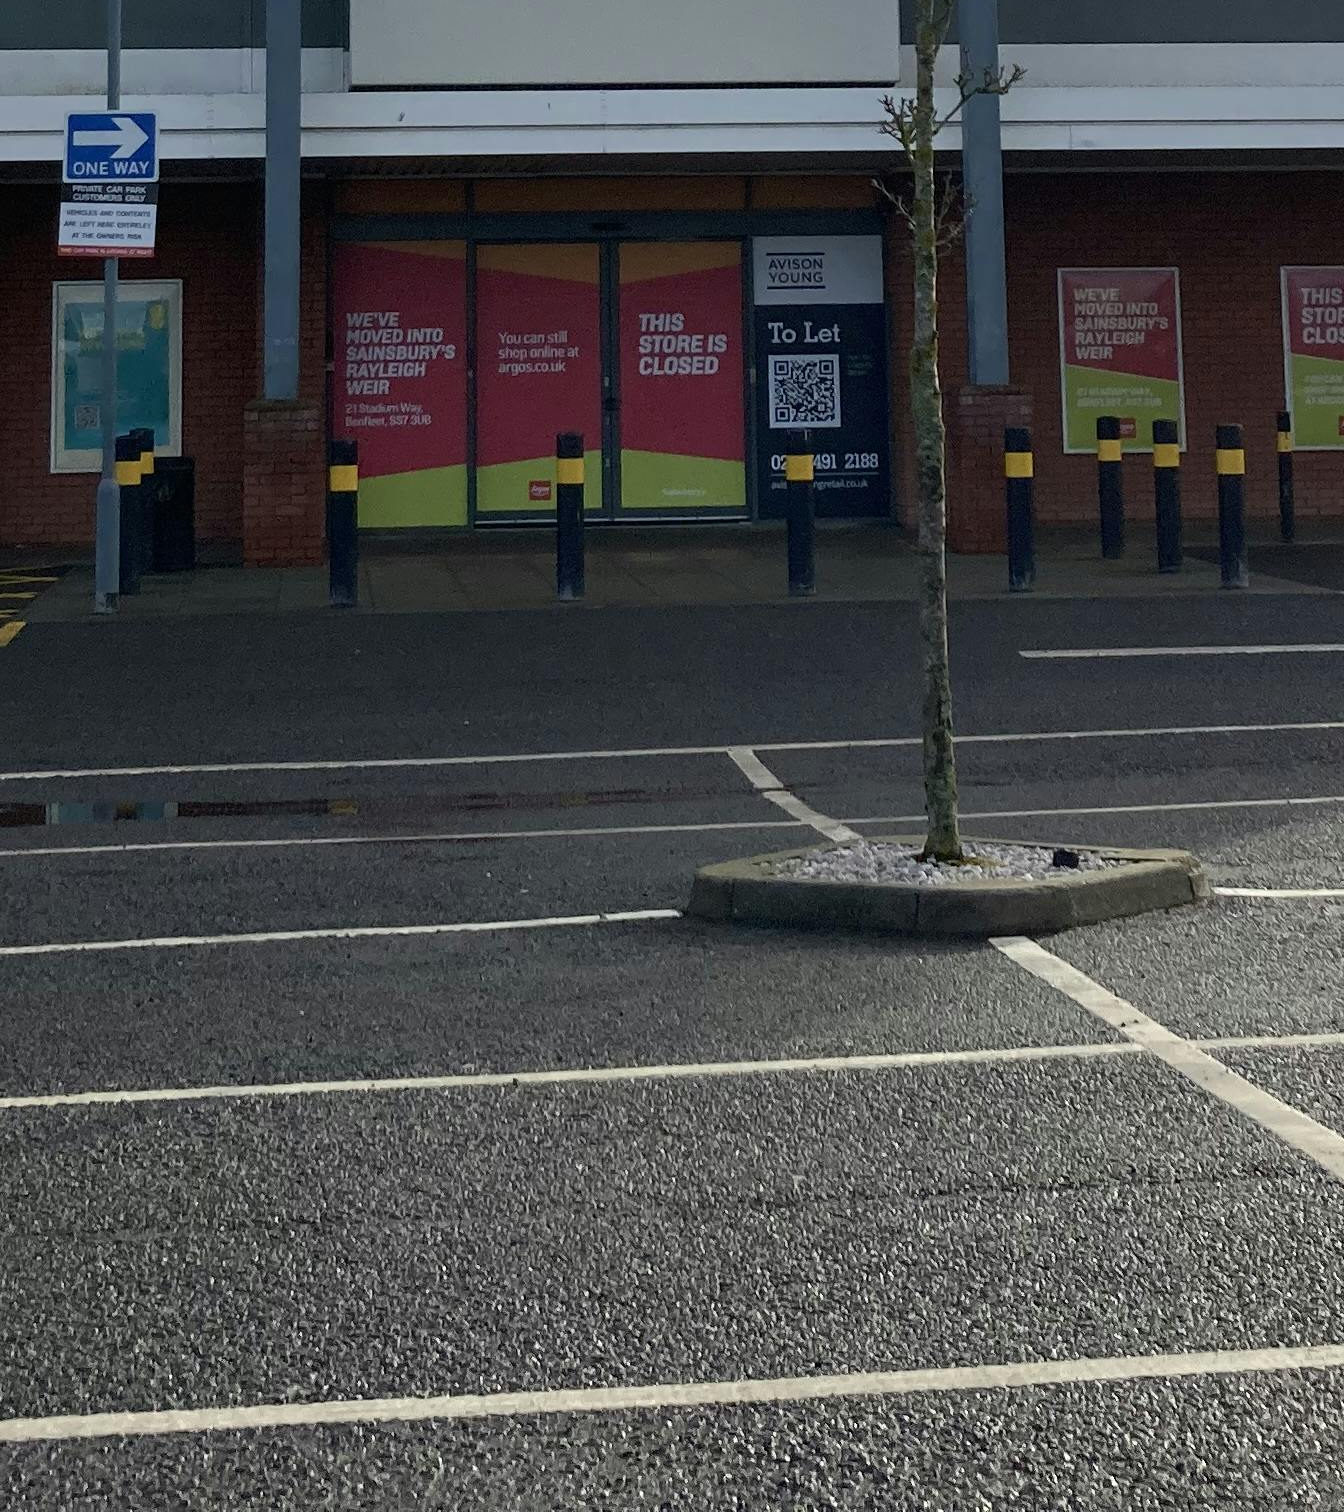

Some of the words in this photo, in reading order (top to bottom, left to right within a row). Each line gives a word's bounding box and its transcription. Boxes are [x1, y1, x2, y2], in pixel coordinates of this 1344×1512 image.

[73, 161, 109, 176] ONE
[114, 160, 149, 175] WAY
[72, 185, 103, 193] PRIVATE
[106, 185, 123, 193] CAR
[125, 186, 146, 194] PARK
[72, 193, 122, 201] CUSTOMERS
[125, 194, 146, 202] ONLY
[116, 210, 151, 218] CONTENTS
[768, 257, 823, 270] AVISON
[769, 271, 824, 284] YOUNG
[1074, 288, 1120, 301] WE'VE
[1301, 287, 1343, 305] THIS
[1074, 302, 1123, 316] MOVED
[1126, 302, 1158, 315] INTO
[346, 312, 400, 328] WE'VE
[638, 312, 686, 332] THIS
[1074, 316, 1169, 330] SAINSBURY'S
[346, 328, 403, 344] MOVED
[407, 328, 444, 343] INTO
[498, 331, 521, 345] You
[523, 334, 545, 345] can
[546, 330, 568, 344] still
[768, 321, 797, 344] To
[803, 320, 841, 343] Let
[1075, 331, 1145, 345] RAYLEIGH
[638, 334, 704, 354] STORE
[708, 333, 728, 353] IS
[346, 344, 456, 361] SAINSBURY'S
[498, 346, 528, 361] shop
[529, 345, 566, 358] online
[567, 346, 579, 358] at
[1076, 346, 1113, 360] WEIR
[346, 362, 427, 378] RAYLEIGH
[497, 360, 566, 376] argos.co.uk
[638, 356, 720, 376] CLOSED
[346, 379, 390, 395] WEIR
[359, 403, 399, 414] Stadium
[844, 452, 879, 469] 2188
